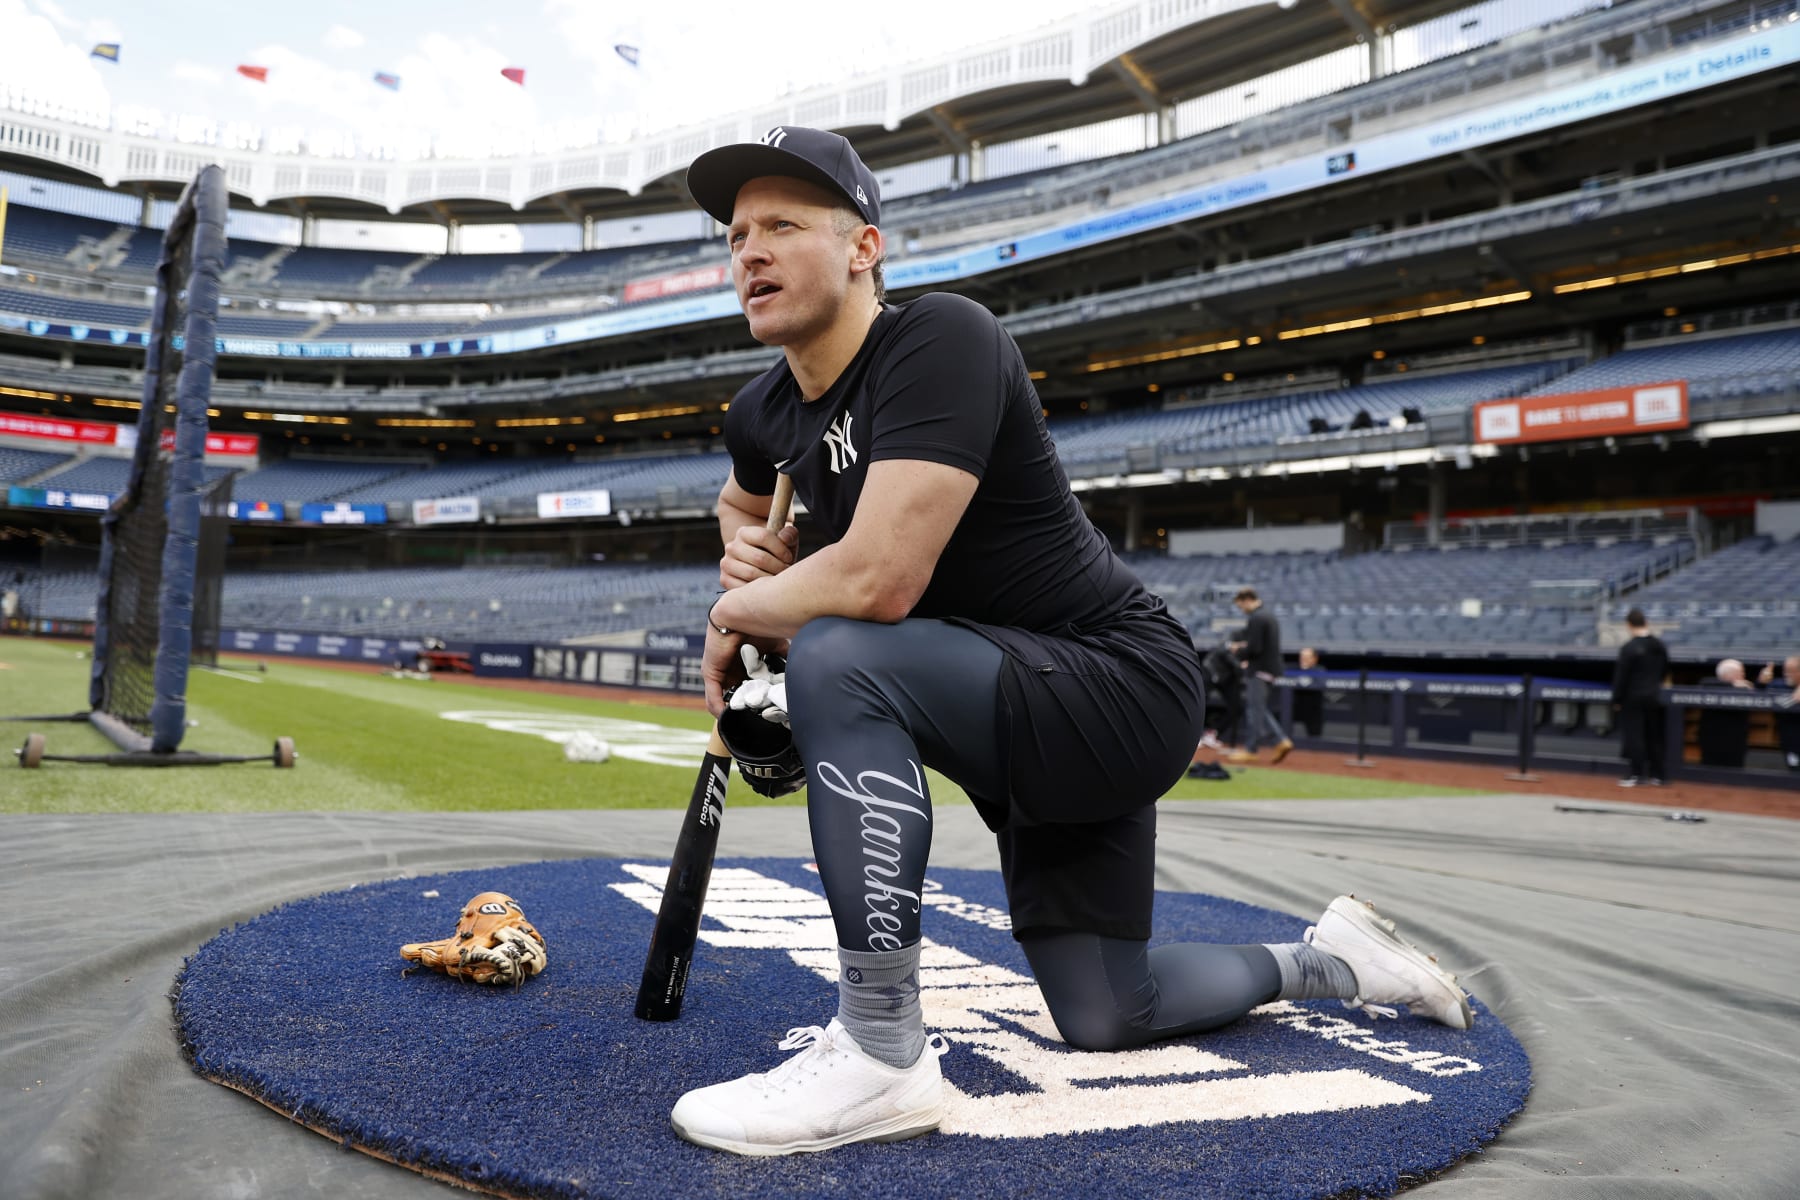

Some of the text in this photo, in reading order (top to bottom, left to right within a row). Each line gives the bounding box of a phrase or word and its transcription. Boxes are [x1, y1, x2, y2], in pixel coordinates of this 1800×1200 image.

[1698, 44, 1772, 76] Details
[823, 409, 858, 475] NY
[699, 772, 716, 827] marucci
